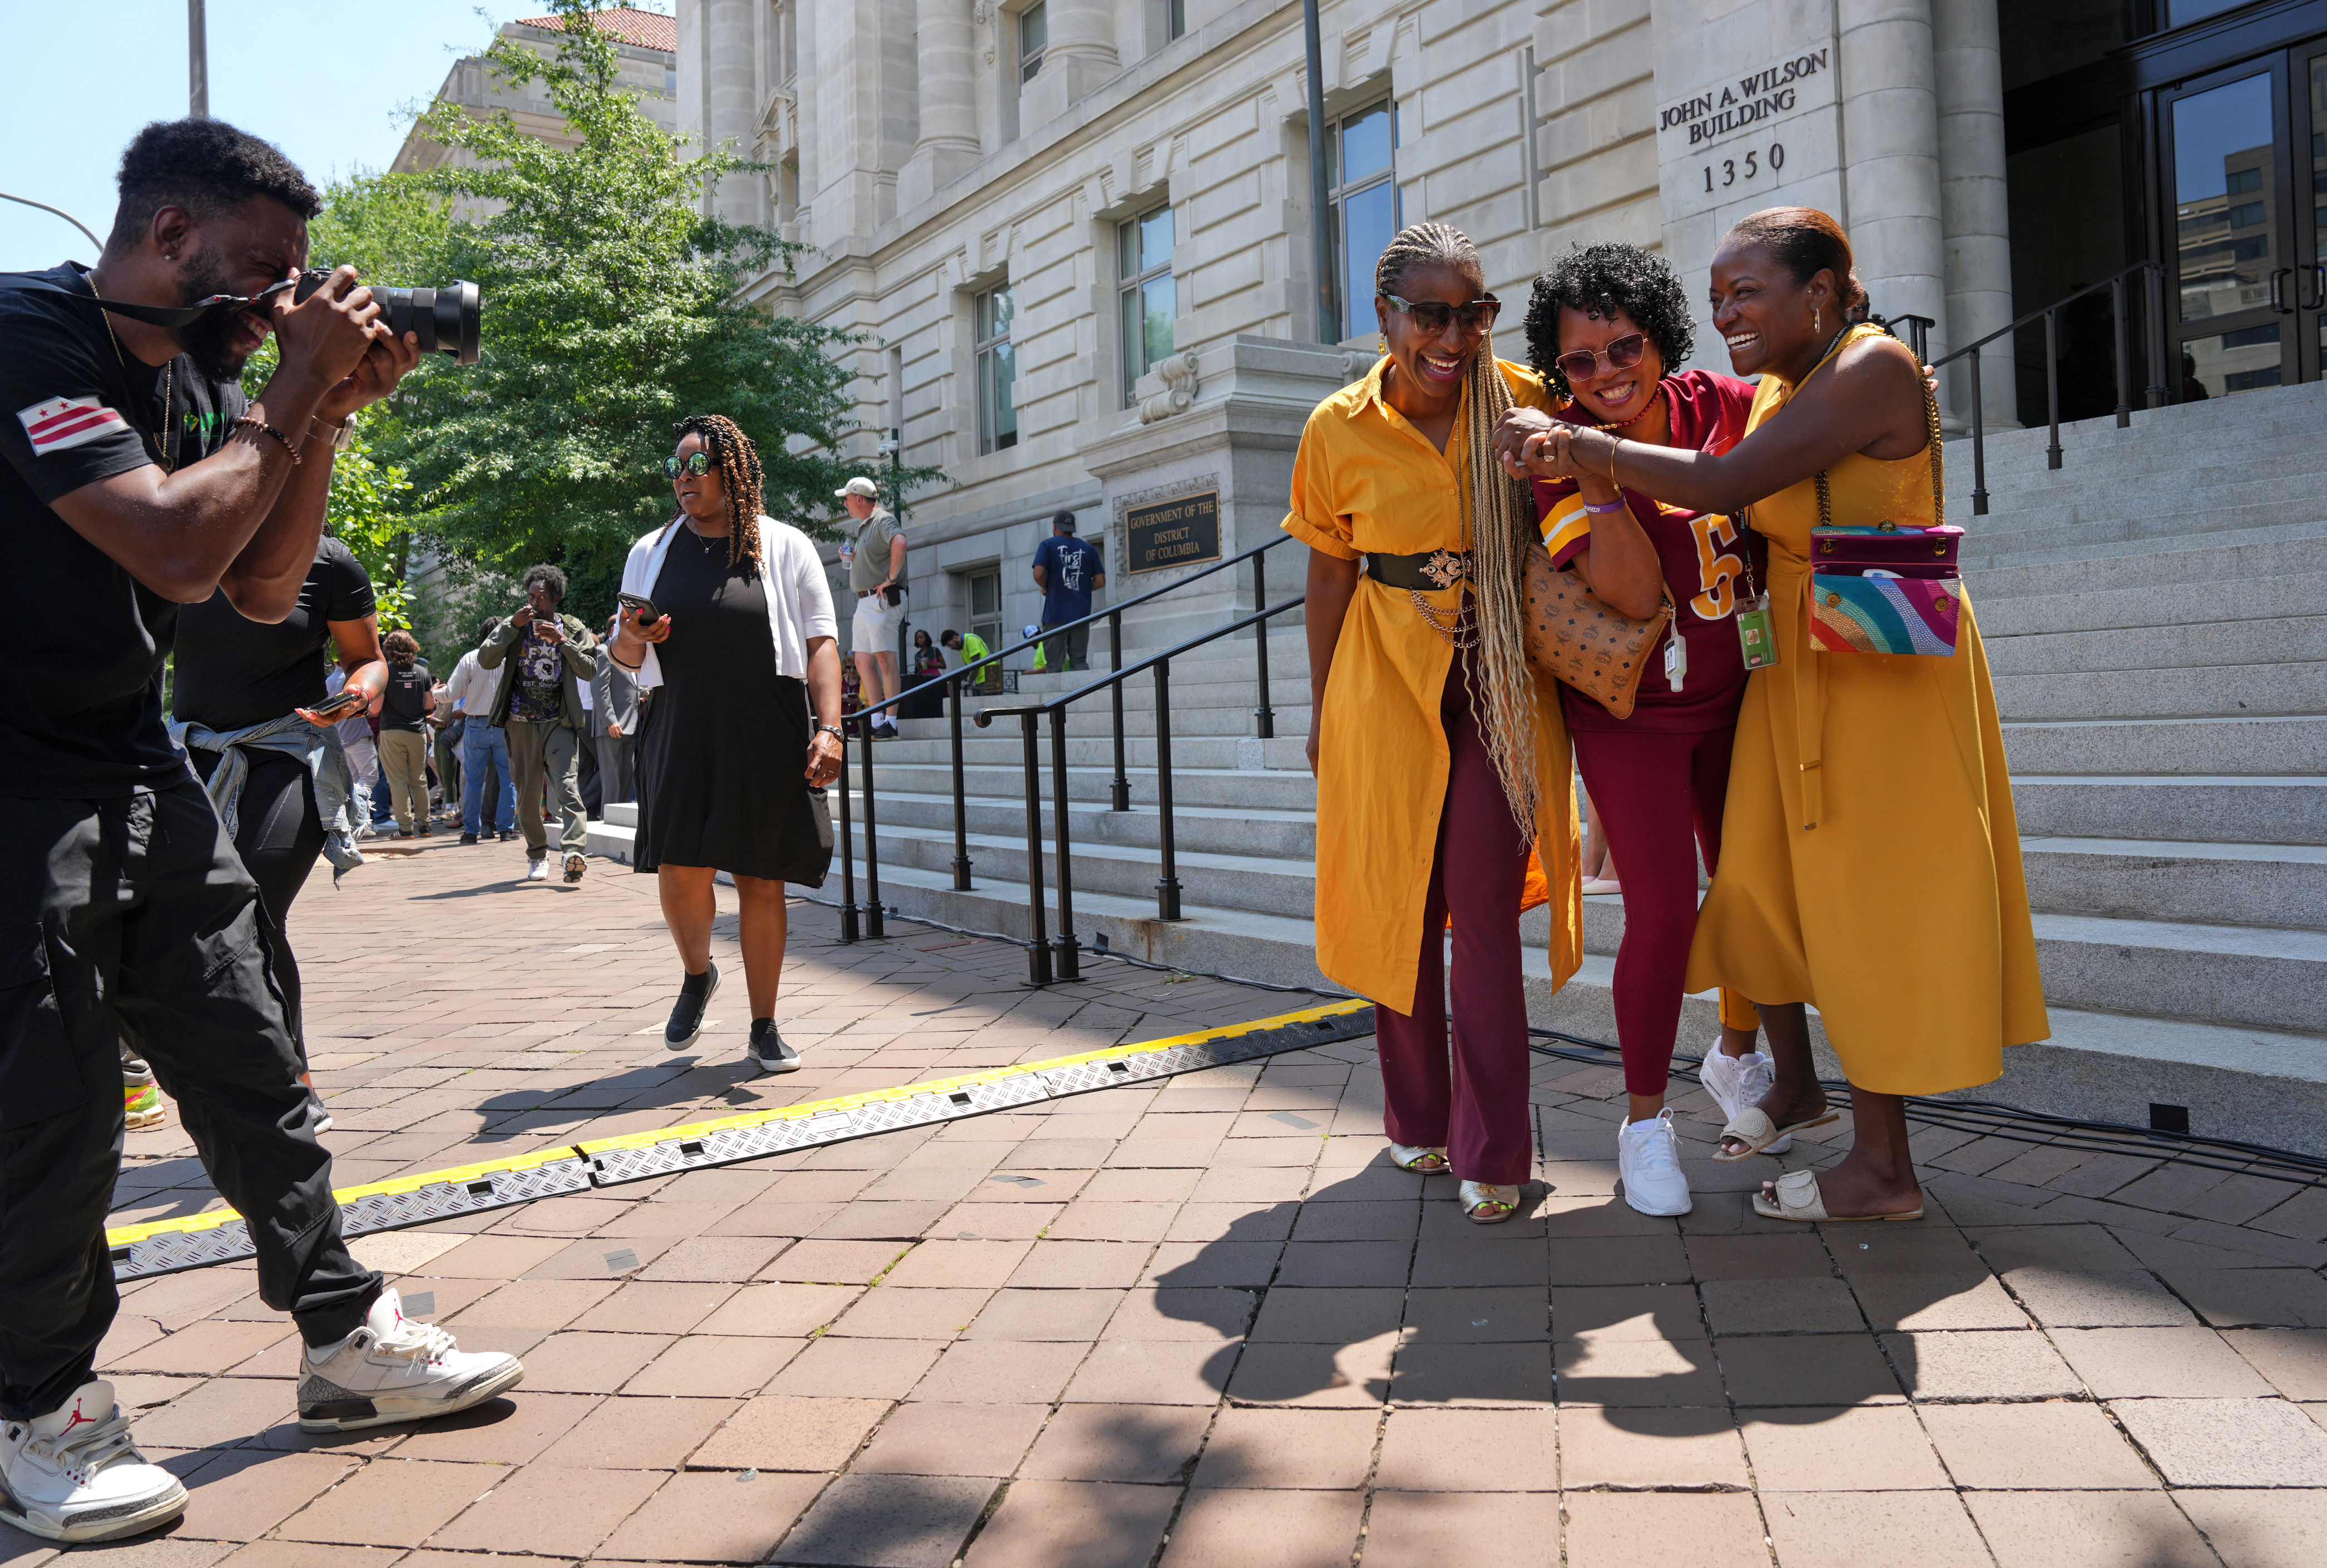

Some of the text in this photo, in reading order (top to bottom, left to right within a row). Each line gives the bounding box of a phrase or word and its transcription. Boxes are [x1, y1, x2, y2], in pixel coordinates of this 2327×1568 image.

[1660, 48, 1828, 131] JOHN A. WILSON
[1689, 88, 1796, 145] BUILDING
[1704, 143, 1784, 192] 1350
[1131, 500, 1215, 529] GOVERNMENT OF THE
[1154, 527, 1190, 545] DISTRICT
[1057, 545, 1086, 567] First
[1146, 542, 1200, 562] OF COLUMBIA
[1688, 513, 1744, 621] 5
[528, 647, 560, 660] F L
